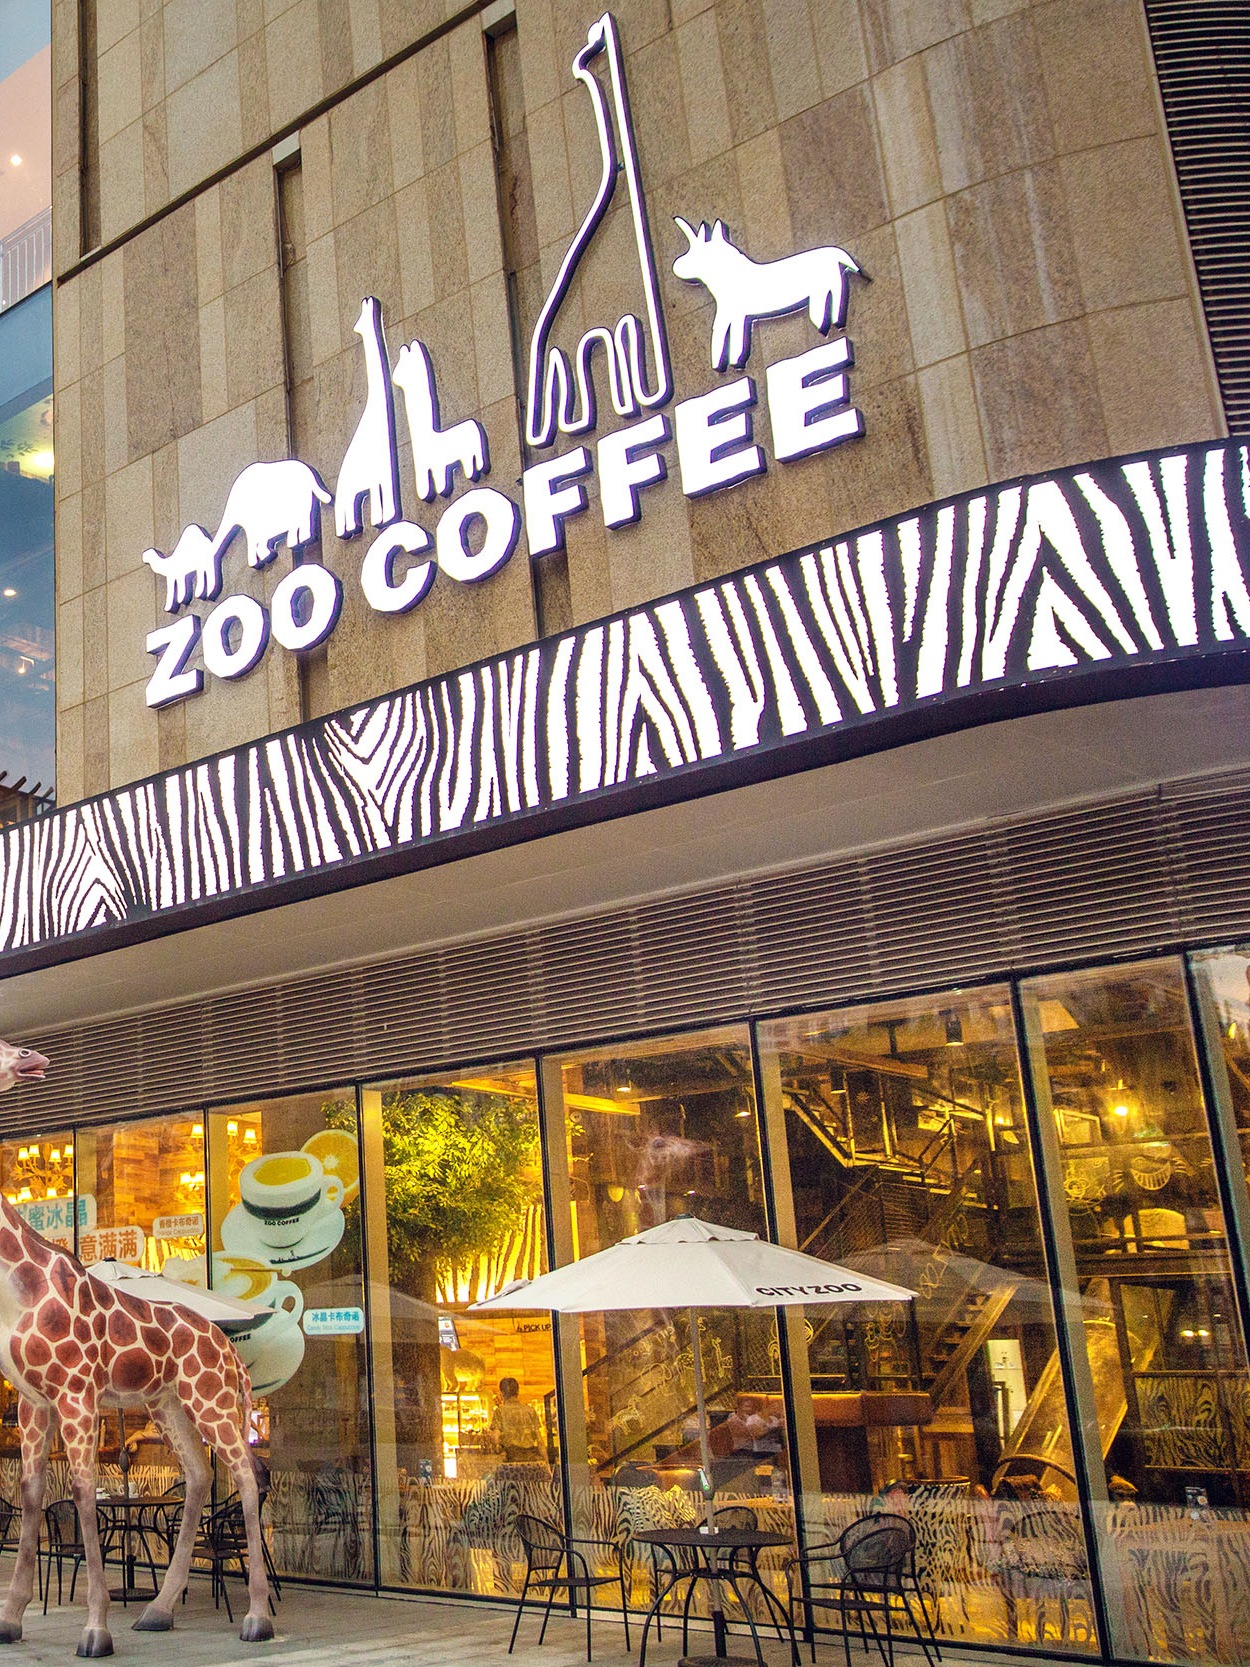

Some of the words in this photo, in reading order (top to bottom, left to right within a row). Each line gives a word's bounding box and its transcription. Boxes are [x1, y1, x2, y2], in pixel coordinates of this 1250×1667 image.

[145, 562, 344, 711] ZOO
[360, 336, 866, 617] COFFEE
[230, 1333, 252, 1343] OFFEE
